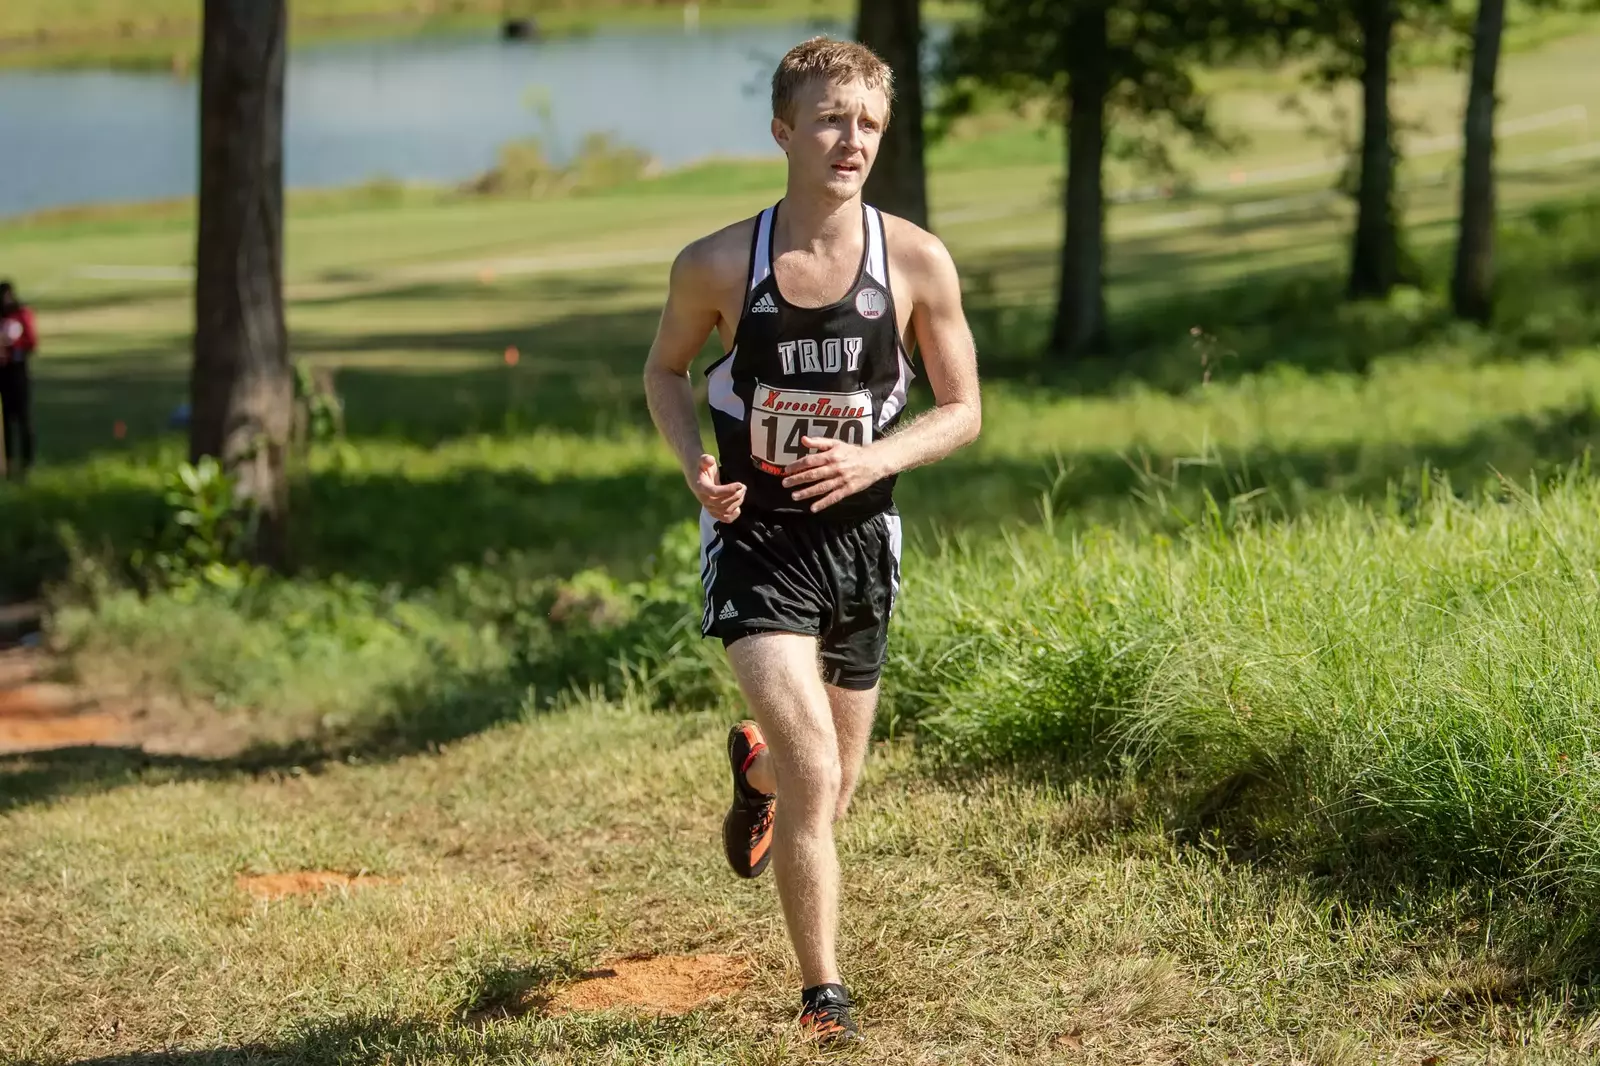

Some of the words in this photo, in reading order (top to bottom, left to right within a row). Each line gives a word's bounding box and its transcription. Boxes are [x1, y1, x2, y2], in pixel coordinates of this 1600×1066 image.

[752, 304, 778, 314] adidas
[777, 337, 863, 375] TROY
[762, 391, 865, 418] XpressTiming
[718, 610, 739, 620] adidas
